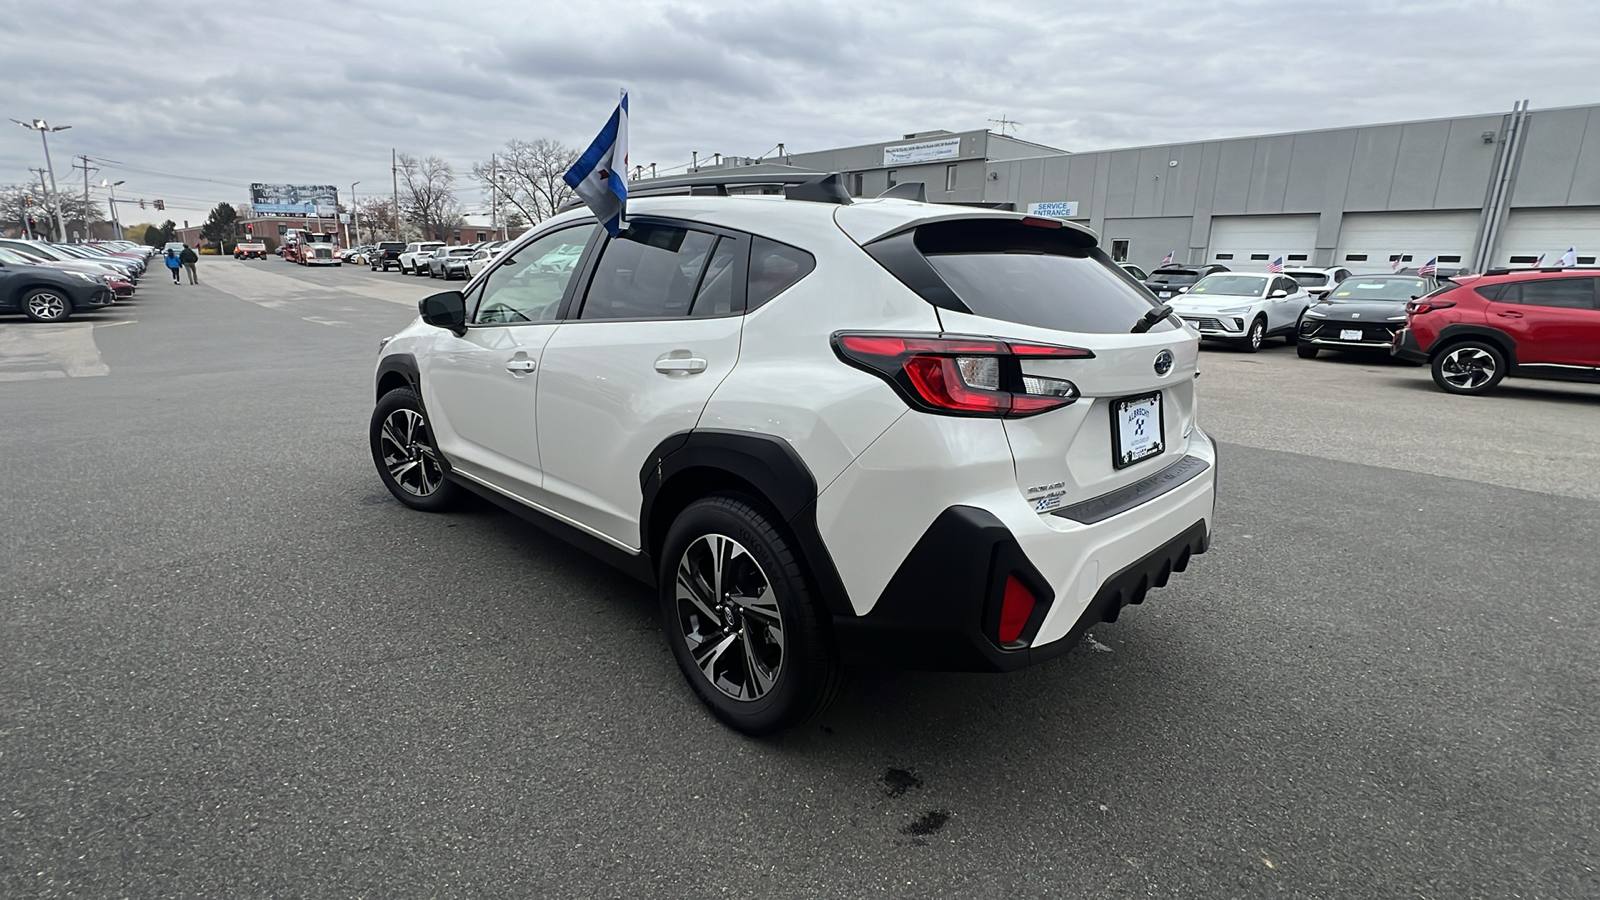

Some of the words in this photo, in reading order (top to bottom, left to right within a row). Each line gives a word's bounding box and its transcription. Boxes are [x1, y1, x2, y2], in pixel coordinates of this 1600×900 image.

[1038, 202, 1068, 210] SERVICE
[1033, 209, 1071, 217] ENTRANCE
[1128, 408, 1150, 423] ALBRECHT
